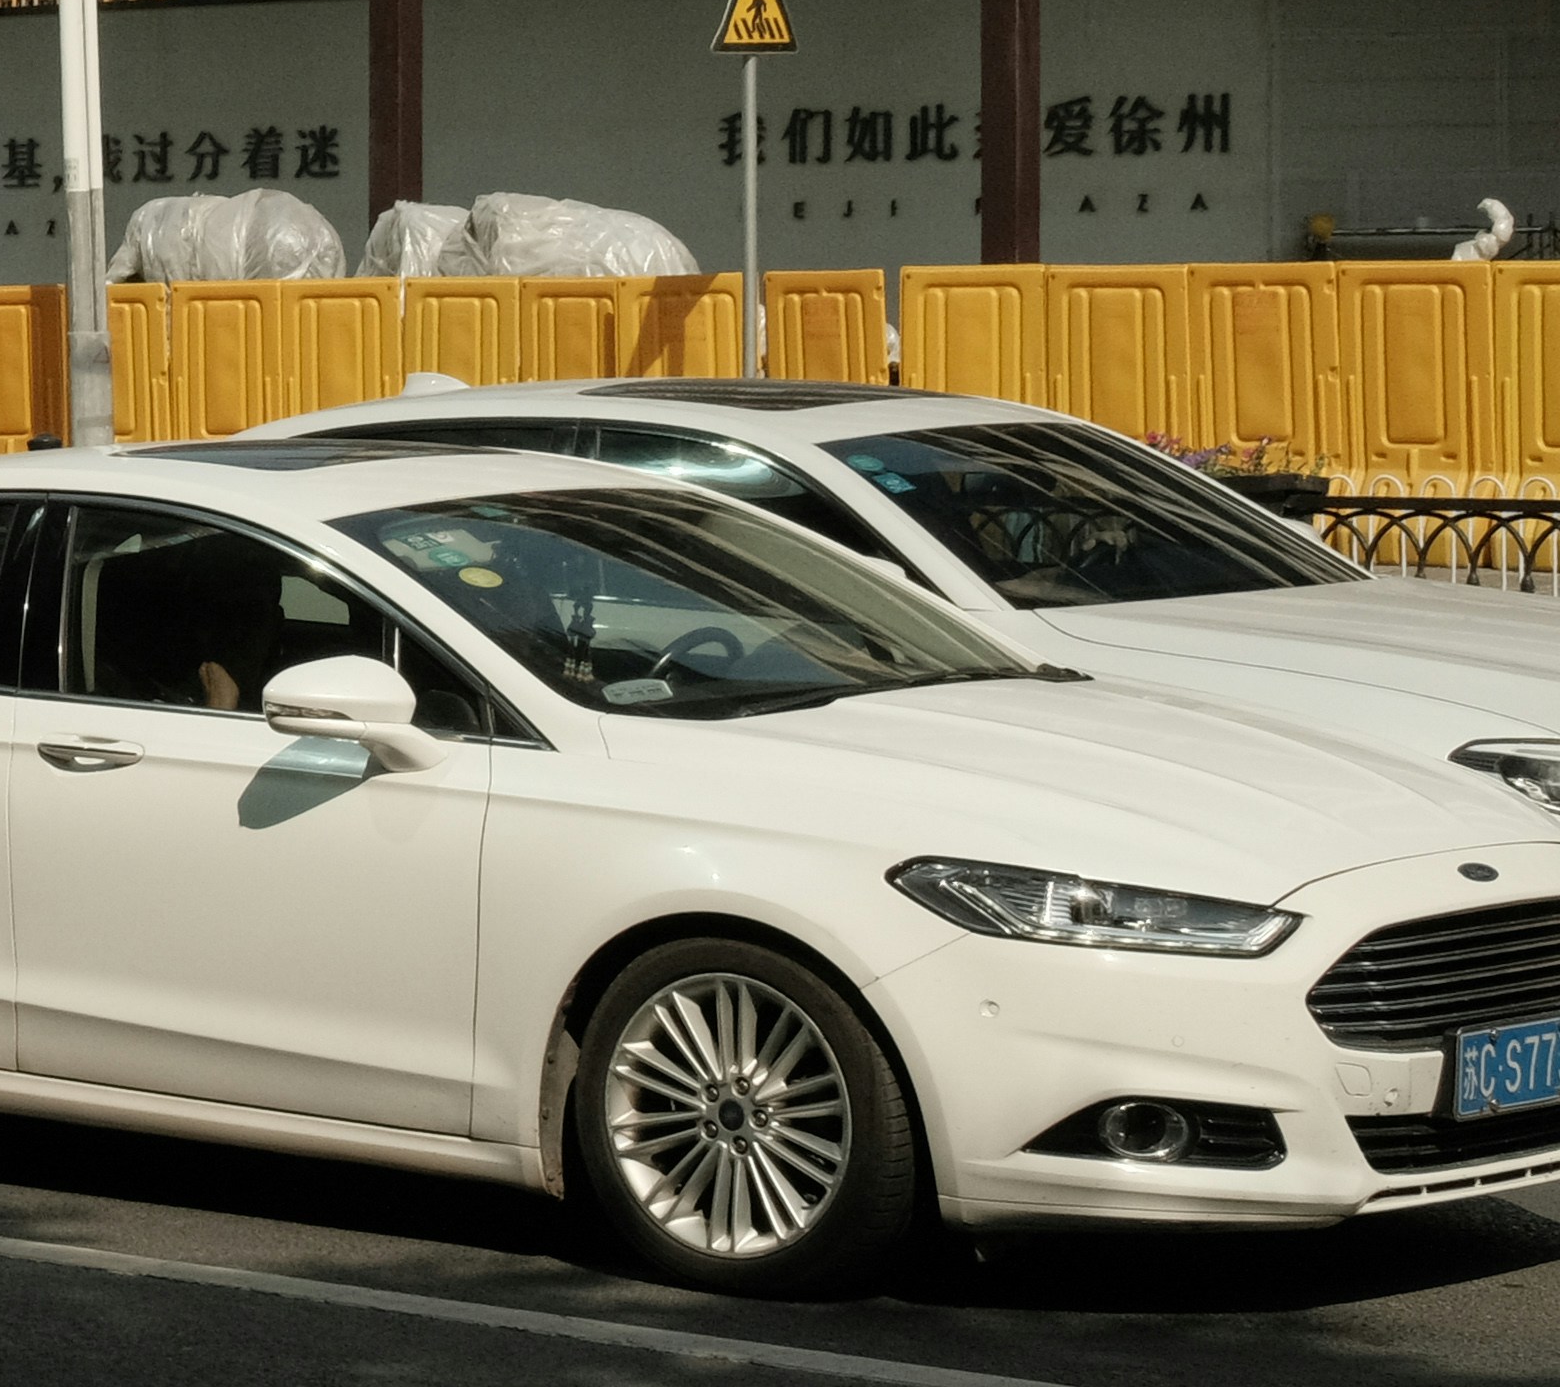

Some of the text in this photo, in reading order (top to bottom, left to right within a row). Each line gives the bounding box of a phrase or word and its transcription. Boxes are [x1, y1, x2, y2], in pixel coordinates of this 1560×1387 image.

[719, 93, 1231, 166] 我们如此爱徐州
[1463, 1032, 1560, 1101] 苏C·S77
